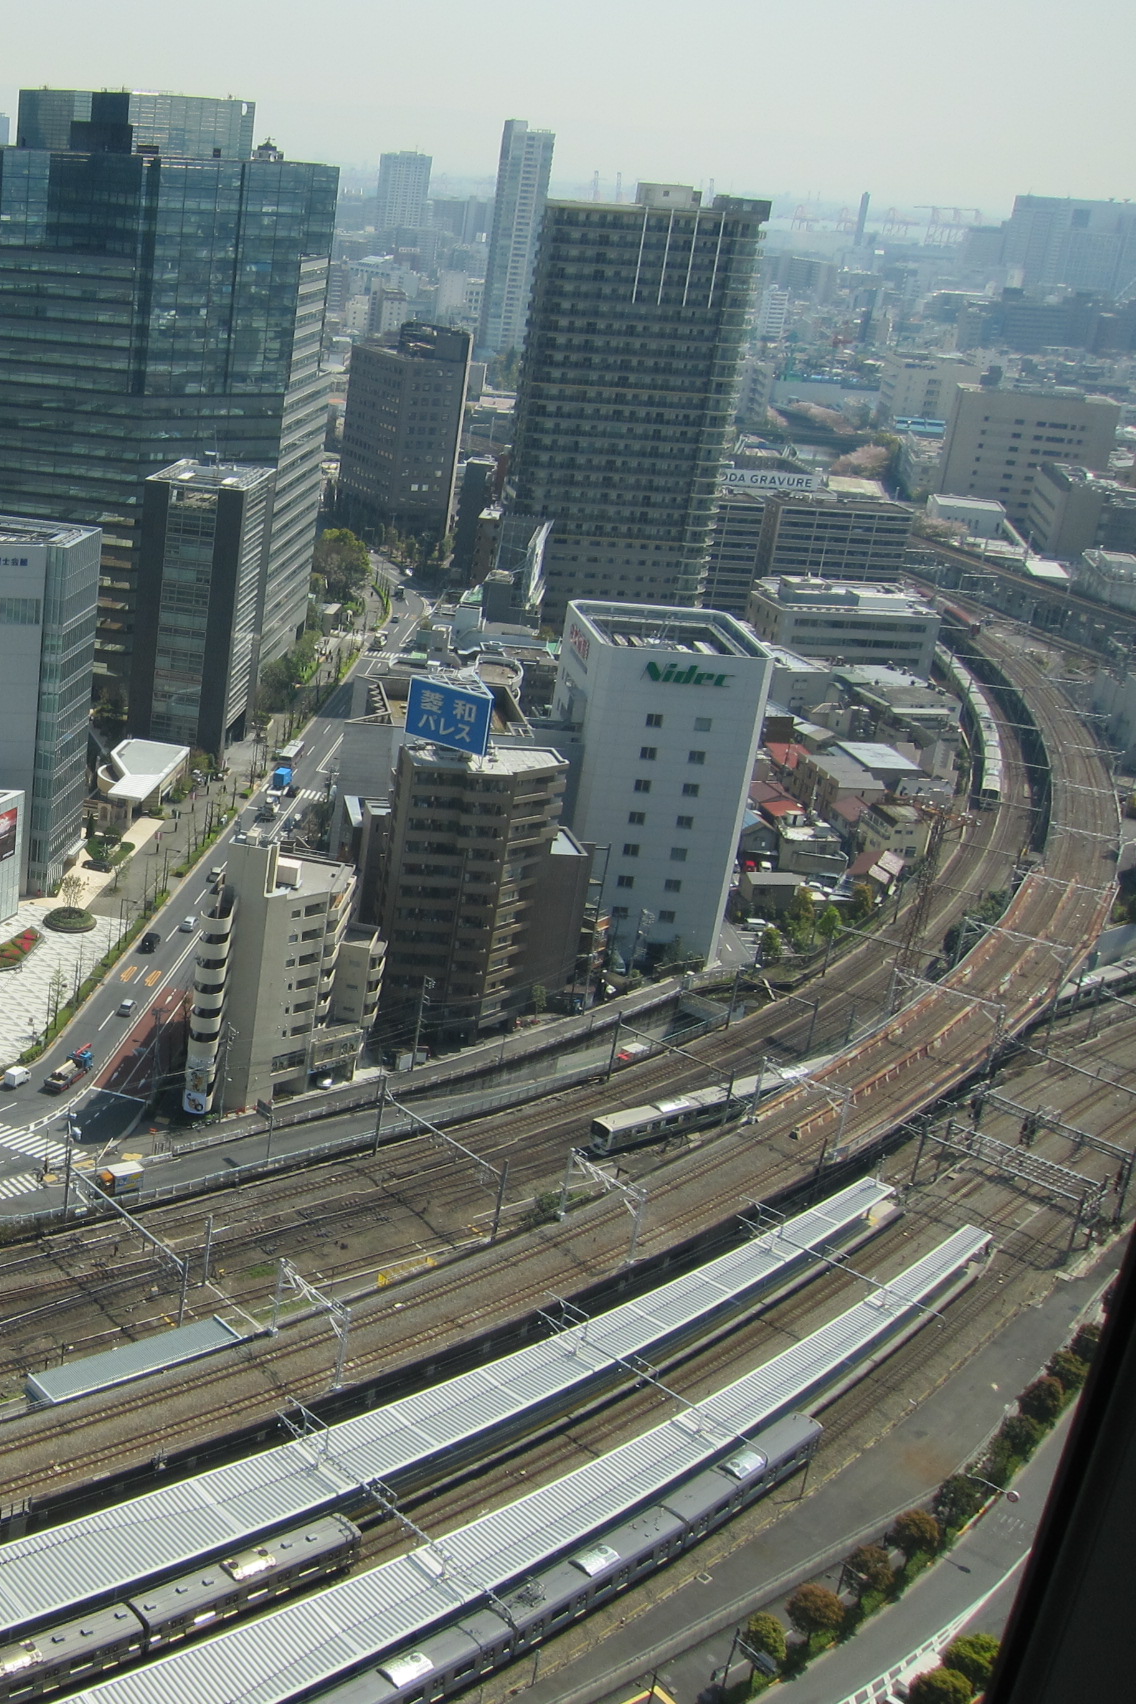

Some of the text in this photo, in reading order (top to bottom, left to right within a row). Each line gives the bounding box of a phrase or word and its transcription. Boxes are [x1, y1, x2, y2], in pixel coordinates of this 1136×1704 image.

[750, 474, 813, 488] GRAVURE
[640, 661, 736, 688] Nidec
[418, 714, 472, 743] パレス
[120, 965, 138, 982] 40
[144, 970, 162, 987] 40
